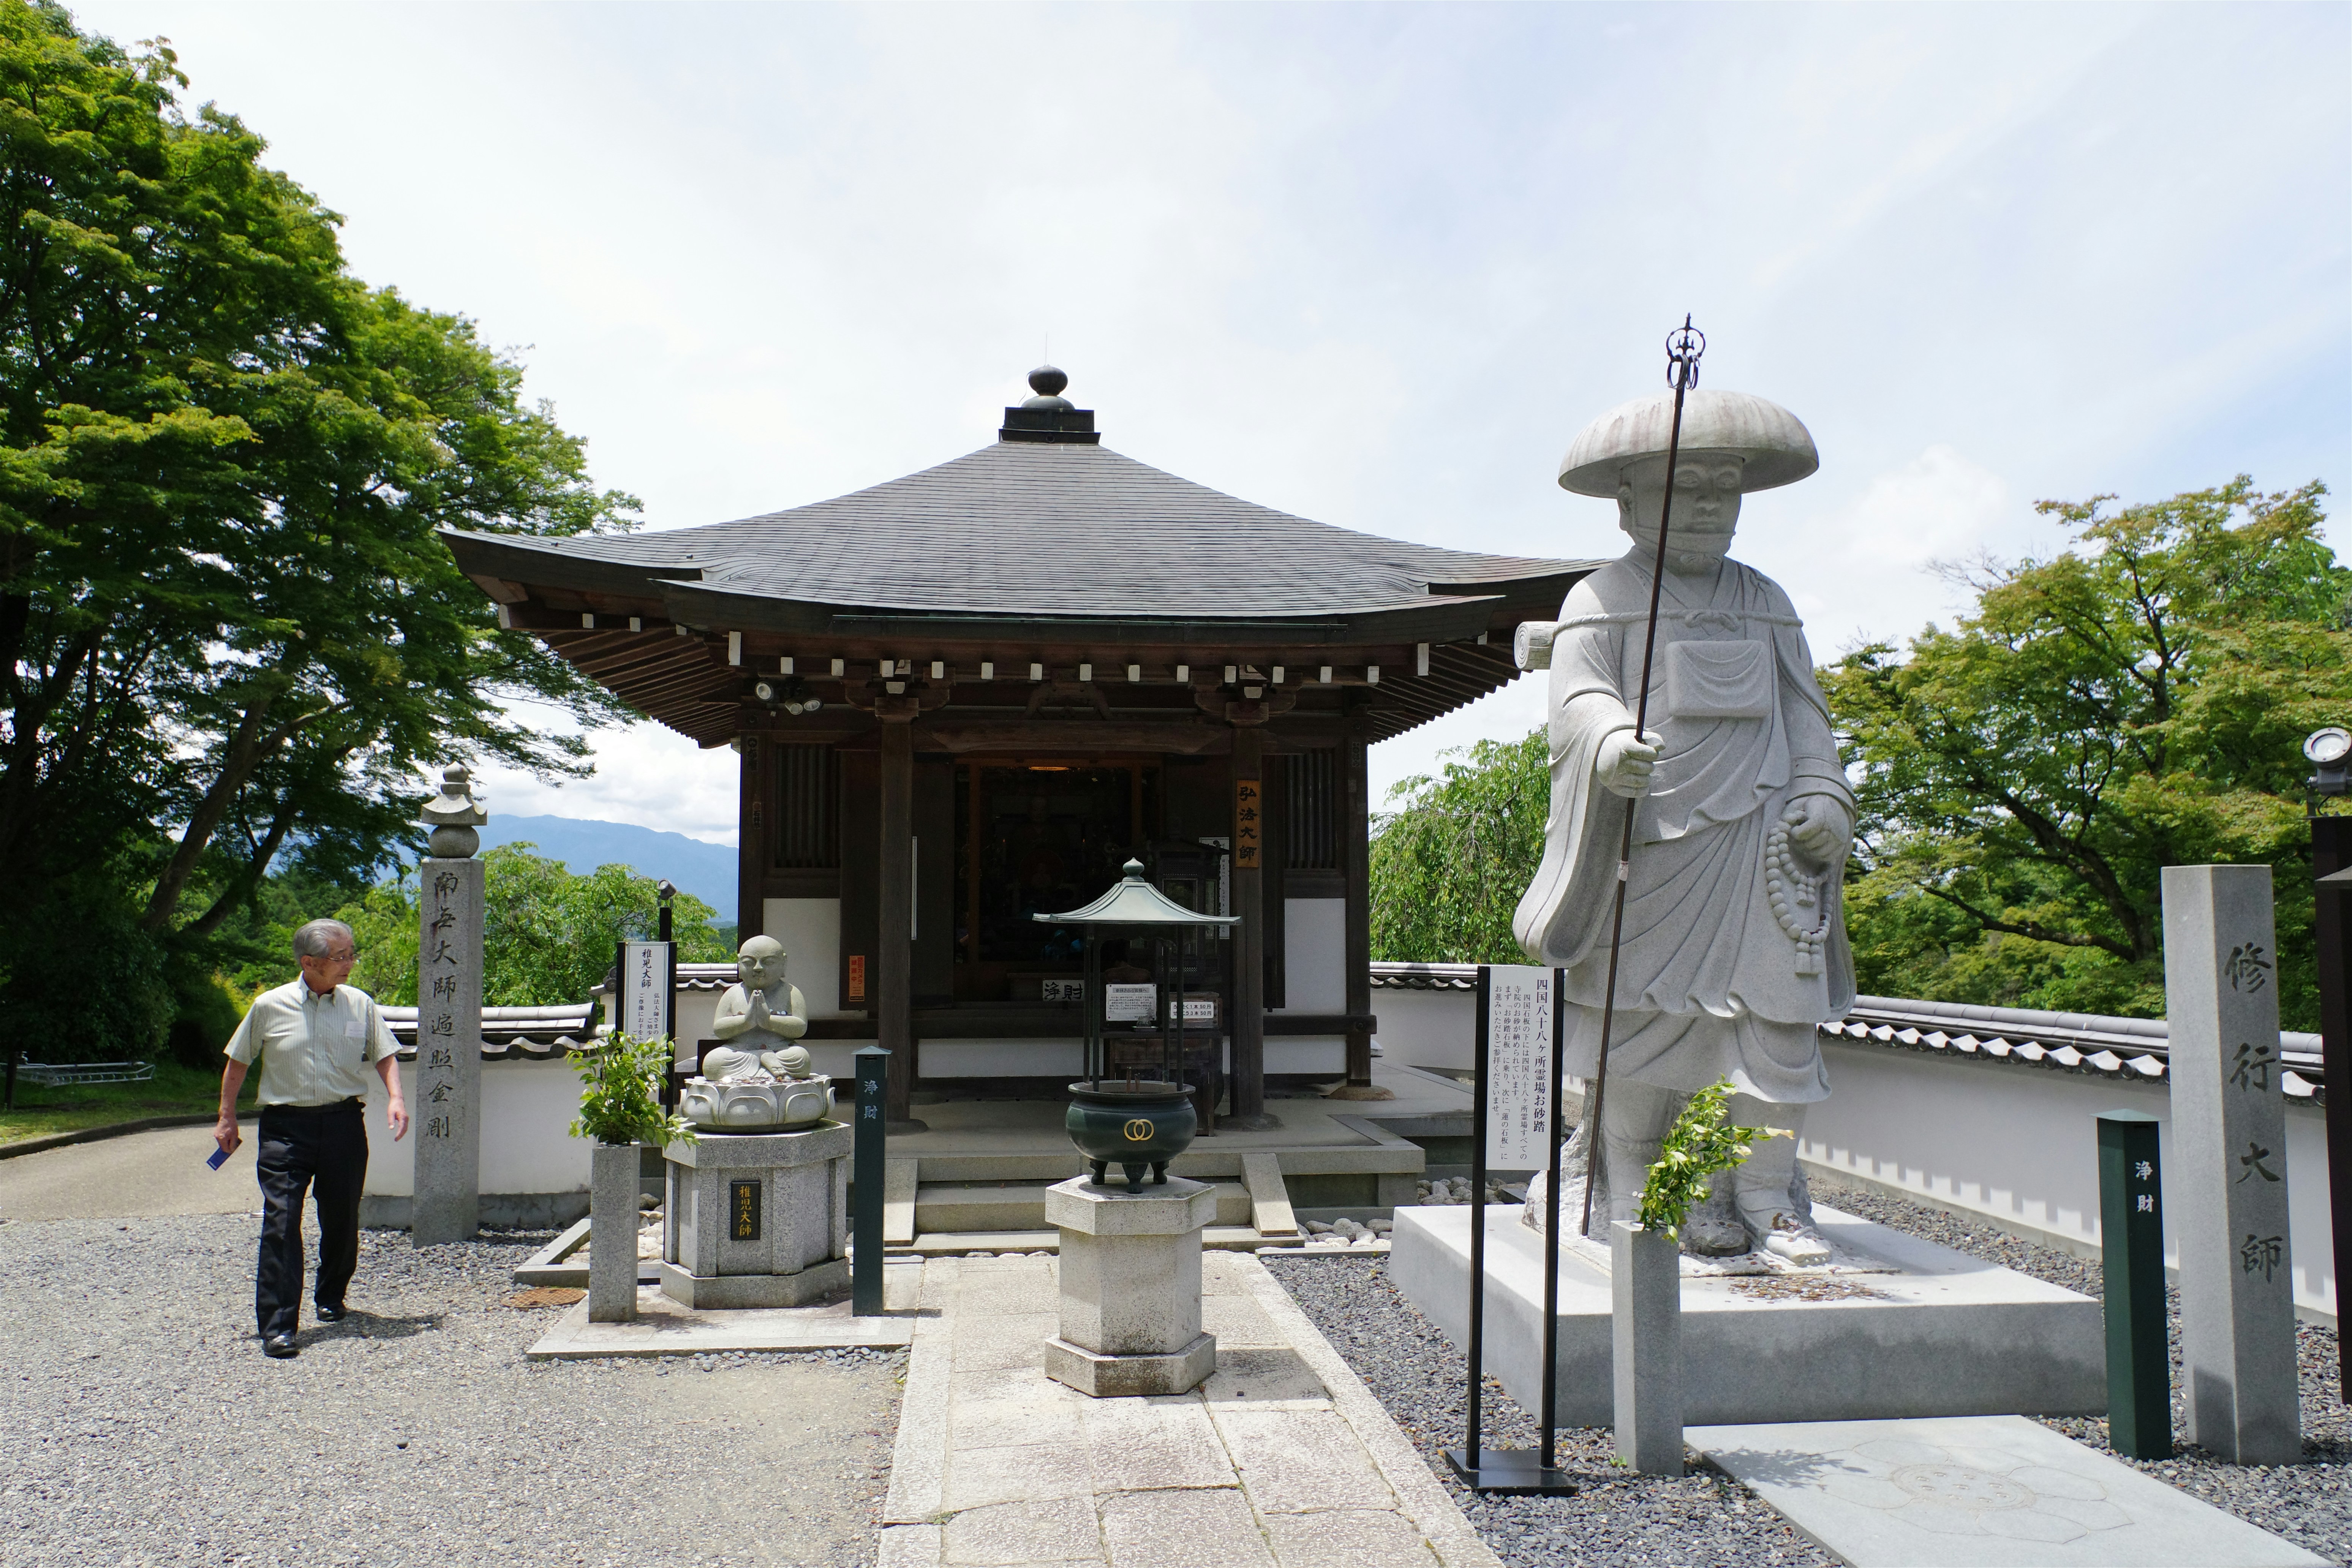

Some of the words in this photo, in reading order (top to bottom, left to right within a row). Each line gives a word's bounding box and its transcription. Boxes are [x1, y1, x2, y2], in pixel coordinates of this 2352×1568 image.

[1239, 786, 1258, 861] 弘法大師
[641, 948, 652, 989] 稚児大師
[1044, 981, 1083, 1001] 浄財
[1492, 985, 1502, 1116] お進みいただきご参拝くださいませ。
[1511, 985, 1522, 1100] 寺院のお砂が納められています。
[863, 1080, 879, 1119] 浄財
[2224, 942, 2283, 1283] 修行大師
[739, 1185, 752, 1236] 稚児大師
[2135, 1160, 2154, 1213] 浄財
